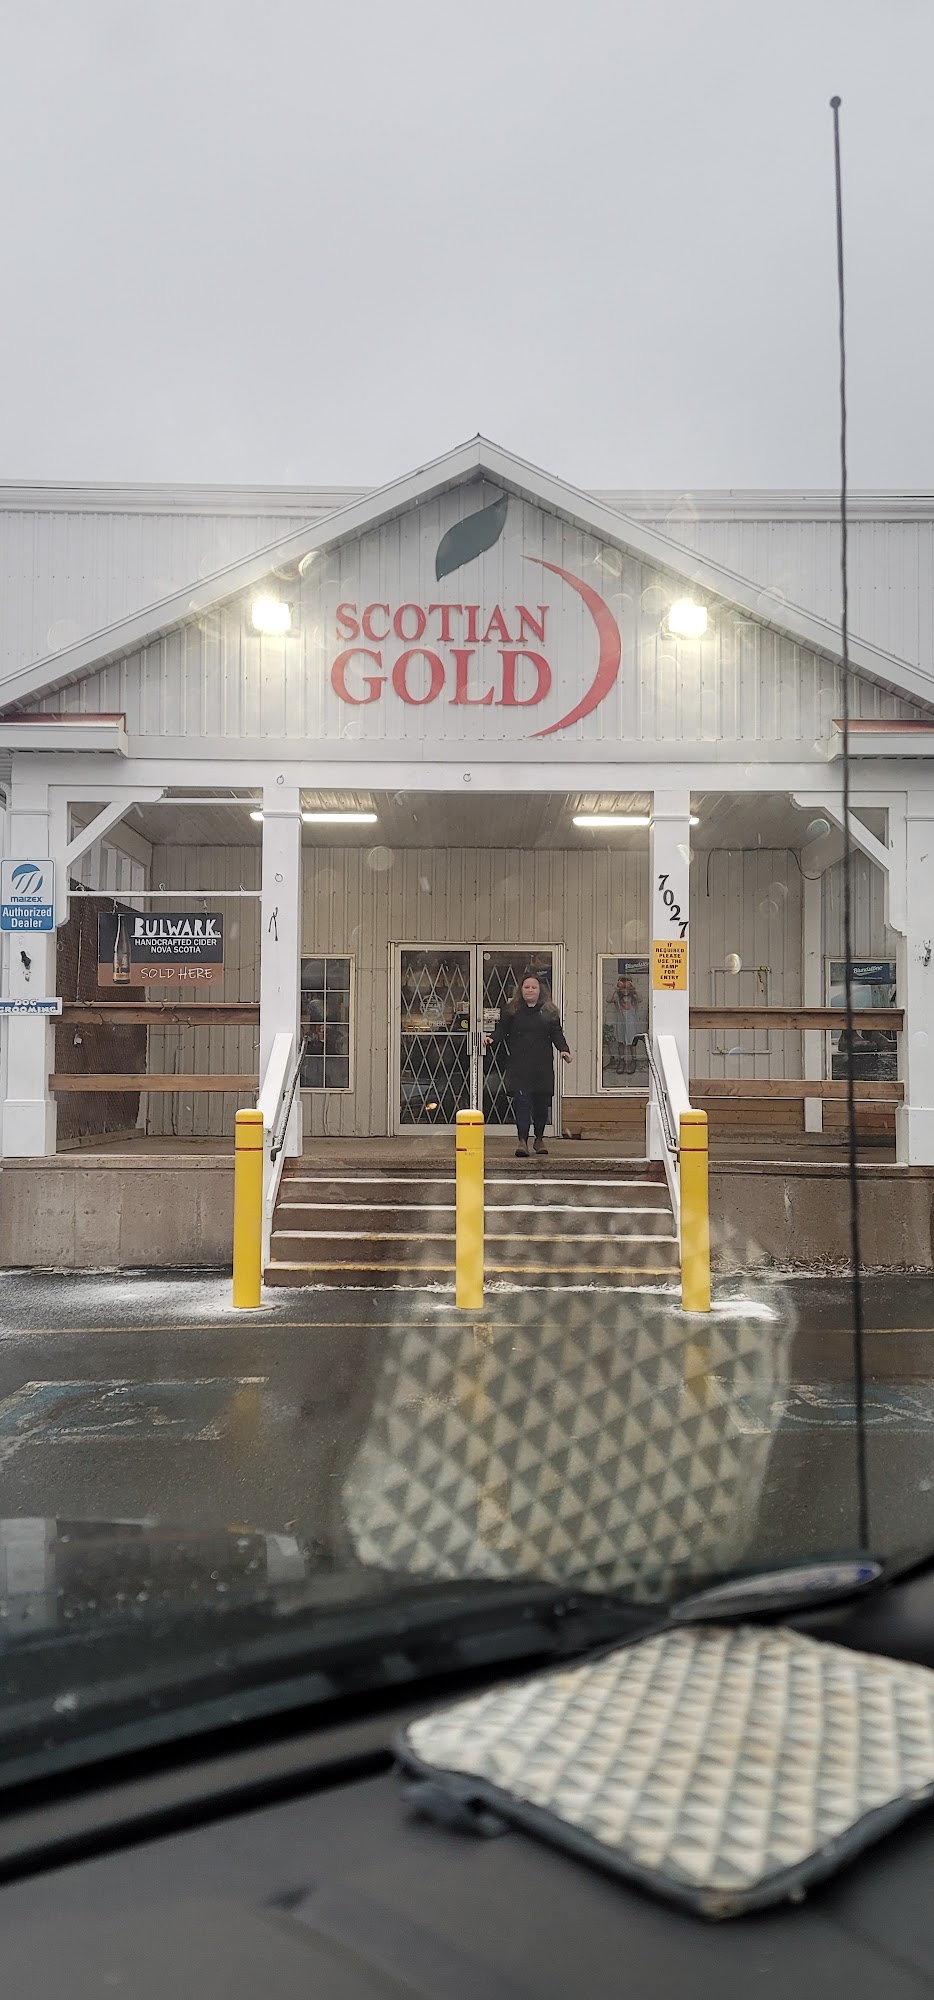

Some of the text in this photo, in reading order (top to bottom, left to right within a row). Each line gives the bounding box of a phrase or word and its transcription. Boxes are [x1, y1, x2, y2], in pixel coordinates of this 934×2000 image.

[335, 603, 550, 642] SCOTIAN
[330, 647, 552, 706] GOLD
[2, 907, 52, 917] Authorized
[658, 874, 689, 939] 7027
[11, 918, 43, 928] Dealer
[134, 917, 217, 936] BULWARK
[150, 946, 201, 954] NOVA SCOTIA
[140, 966, 213, 980] SOLD HERE
